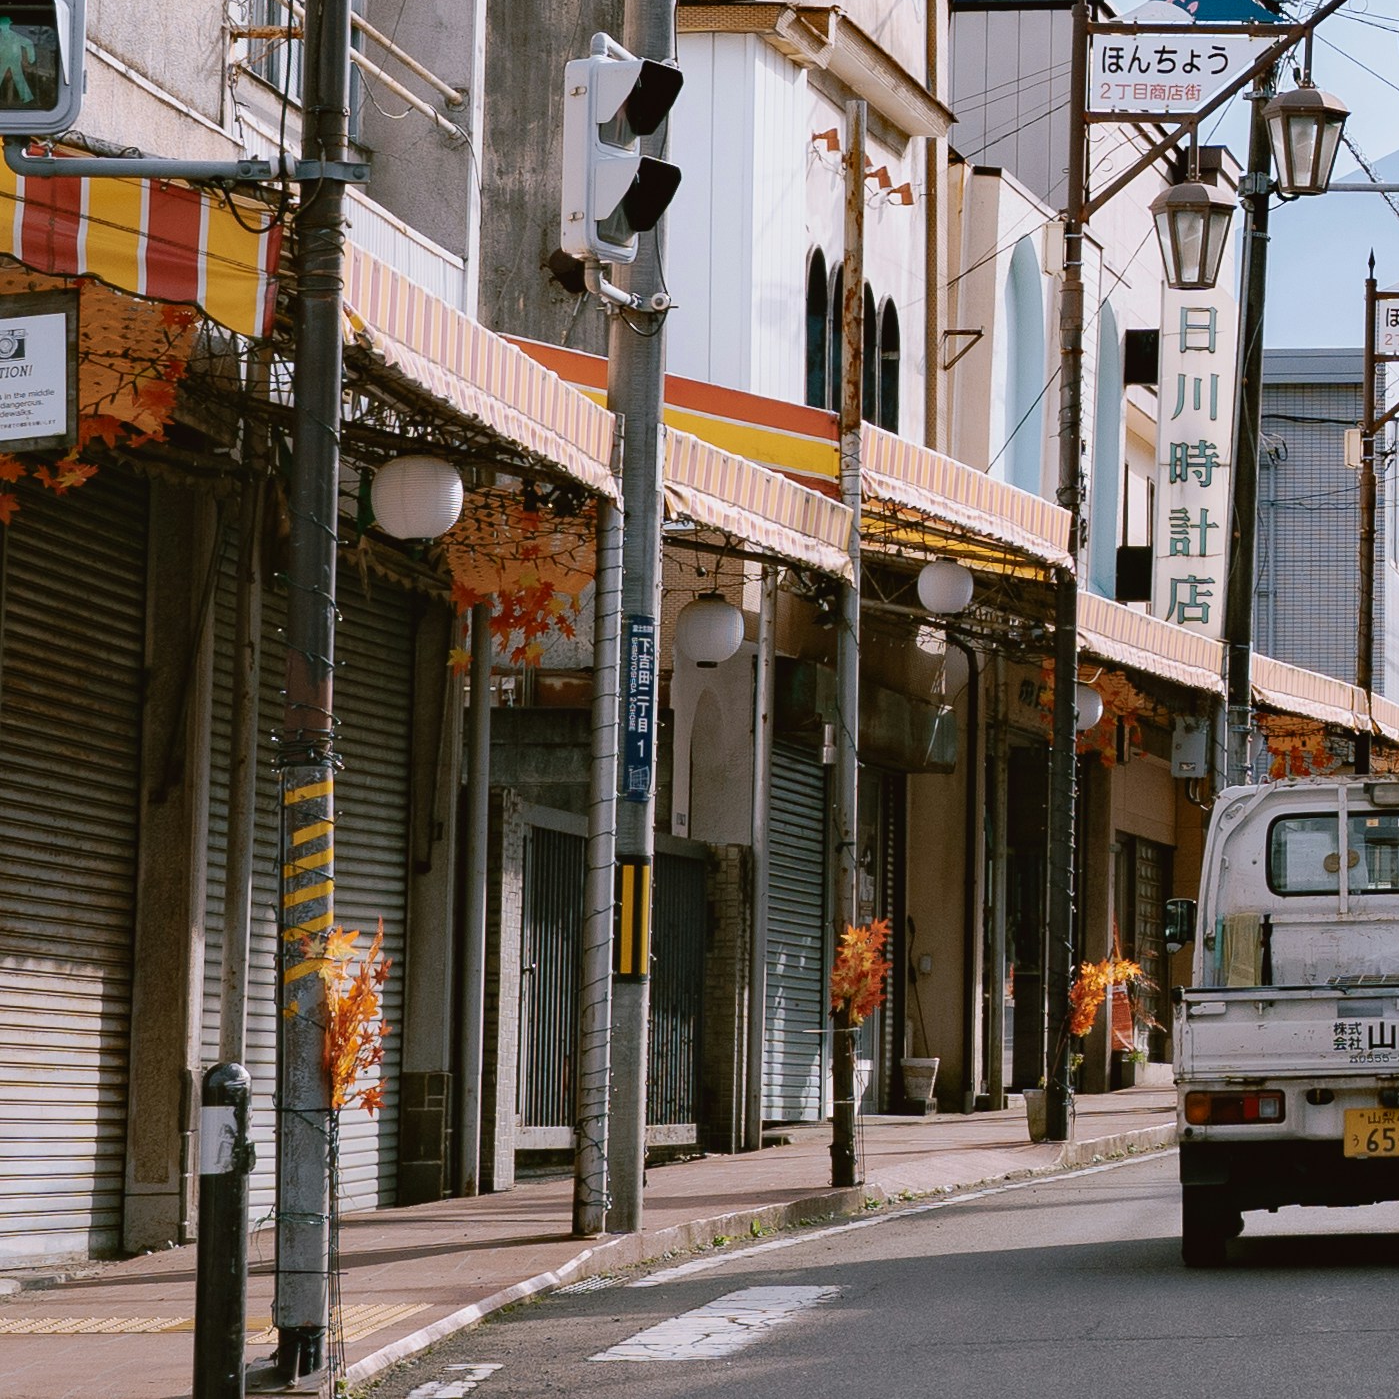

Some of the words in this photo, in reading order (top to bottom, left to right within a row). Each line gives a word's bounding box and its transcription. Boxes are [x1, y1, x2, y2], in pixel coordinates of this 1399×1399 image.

[1102, 45, 1228, 75] ほんちょう
[1100, 83, 1201, 102] 2丁目商店街
[1165, 305, 1220, 624] 日川時計店
[637, 638, 651, 733] 下吉田二丁目
[637, 738, 645, 759] 1
[1333, 1021, 1362, 1036] 株式
[1333, 1036, 1362, 1051] 会社
